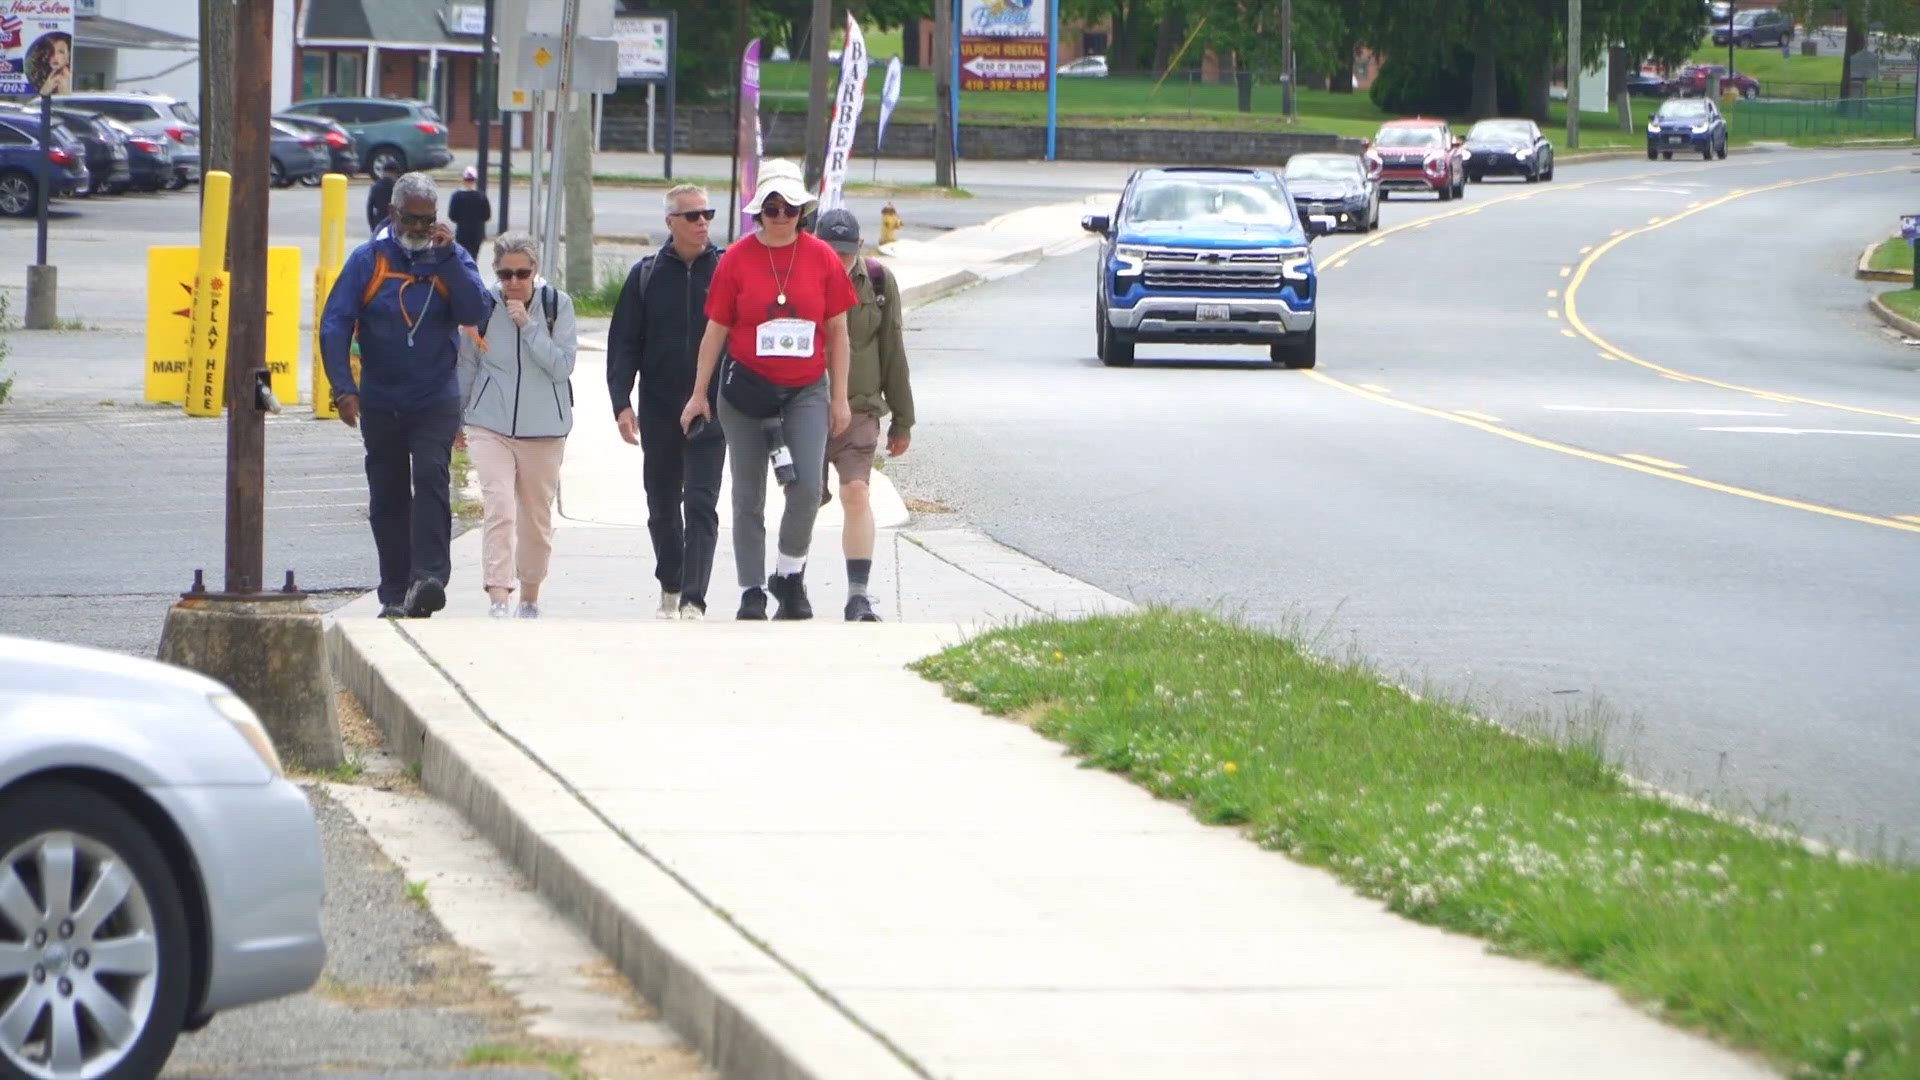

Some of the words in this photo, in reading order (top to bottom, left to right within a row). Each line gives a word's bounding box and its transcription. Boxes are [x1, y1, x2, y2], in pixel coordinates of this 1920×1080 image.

[10, 0, 35, 12] Hair
[37, 0, 70, 14] Salon
[961, 43, 1000, 56] ULRICH
[1004, 43, 1045, 56] RENTAL
[1009, 62, 1042, 71] BUILDING
[832, 41, 862, 171] BARBER
[208, 299, 219, 350] PLAY
[203, 359, 216, 410] HERE
